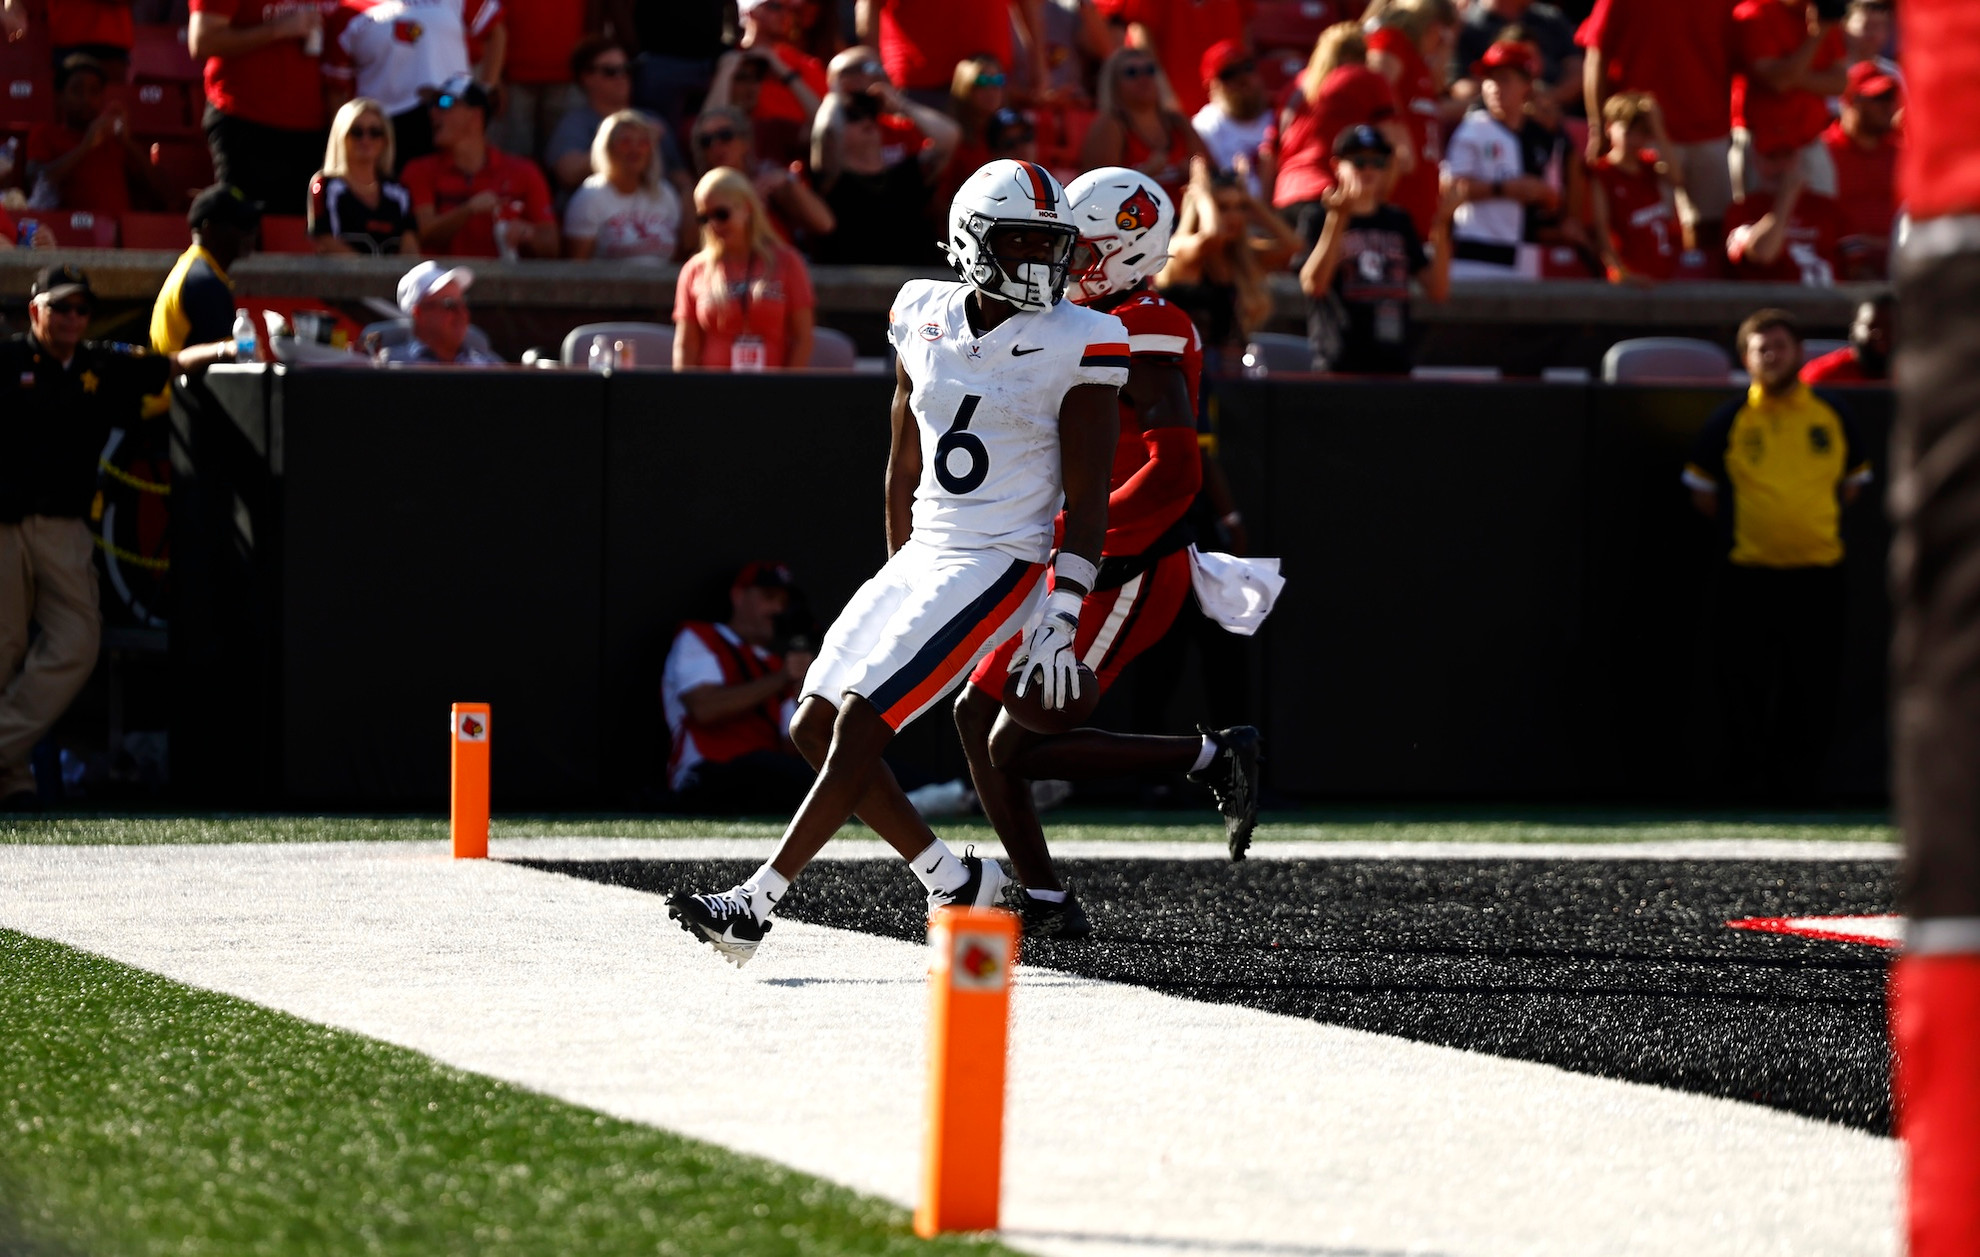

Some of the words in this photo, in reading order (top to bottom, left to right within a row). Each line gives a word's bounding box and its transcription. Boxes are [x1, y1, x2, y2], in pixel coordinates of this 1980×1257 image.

[1039, 211, 1058, 219] HOOS
[1137, 296, 1166, 306] 21
[934, 394, 989, 495] 6
